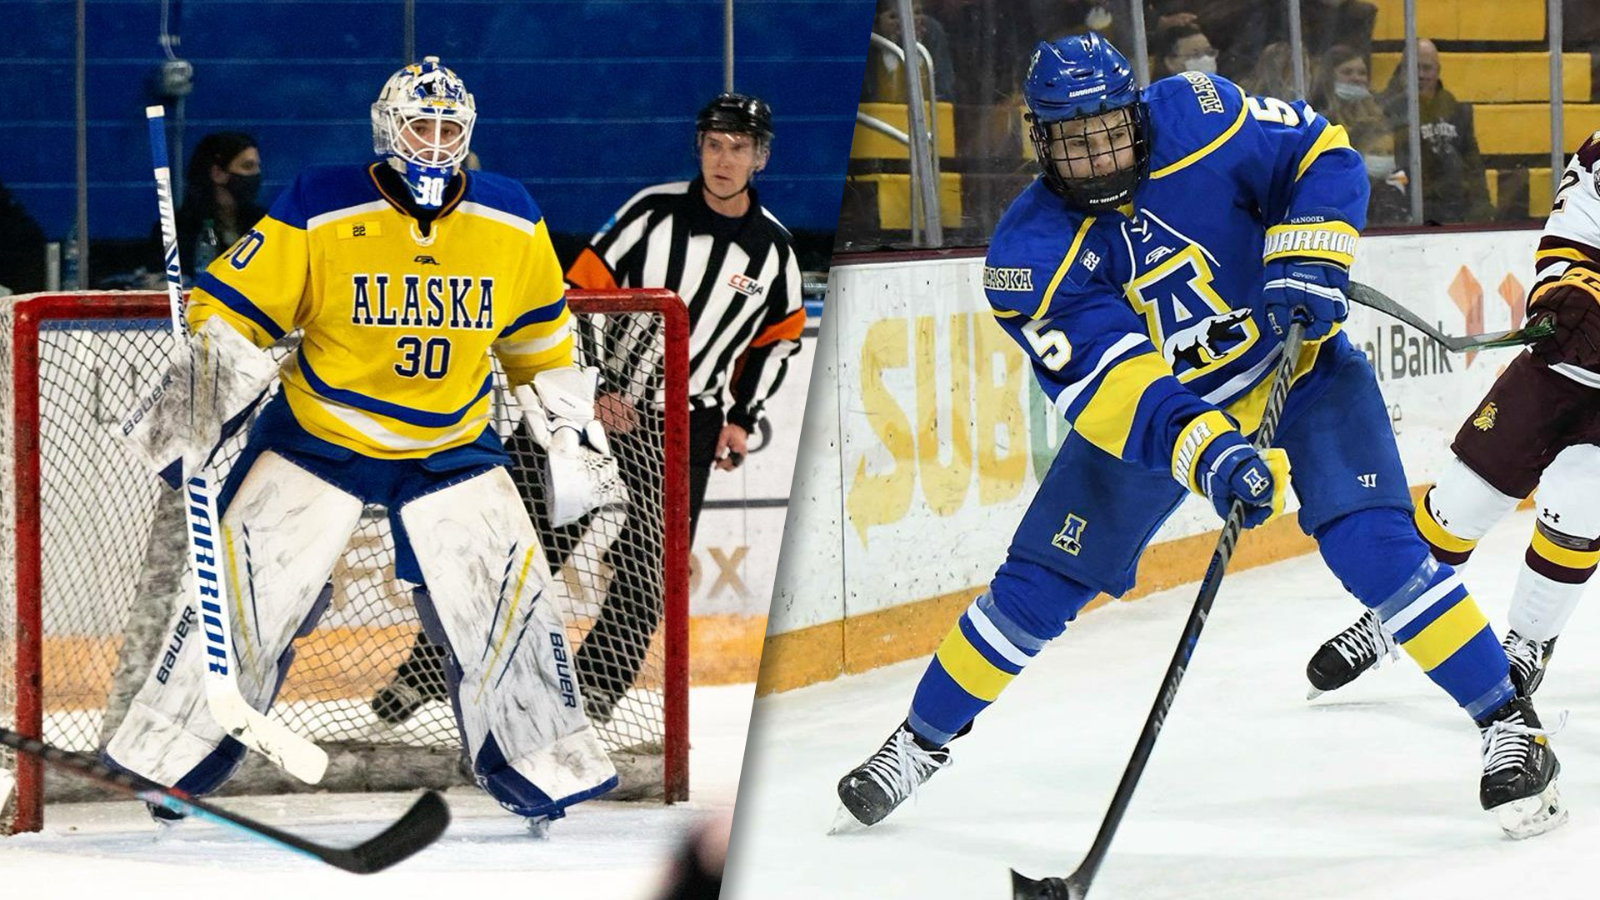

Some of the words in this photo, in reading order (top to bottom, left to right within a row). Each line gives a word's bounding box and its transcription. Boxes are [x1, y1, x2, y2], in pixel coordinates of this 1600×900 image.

[1246, 97, 1300, 127] 5
[416, 176, 444, 206] 30
[352, 226, 366, 237] 22
[1291, 216, 1325, 225] NANOOKS
[223, 228, 265, 271] 0
[1083, 251, 1100, 271] 22
[730, 274, 764, 295] CCHA
[1292, 271, 1318, 281] COVERT
[351, 274, 494, 330] ALASKA
[393, 336, 451, 379] 30
[1020, 318, 1072, 372] 5
[1391, 321, 1453, 380] Bank
[122, 374, 173, 436] BAUER
[187, 477, 228, 675] WARRIOR
[156, 605, 196, 685] BAUER
[549, 632, 576, 708] BAUER
